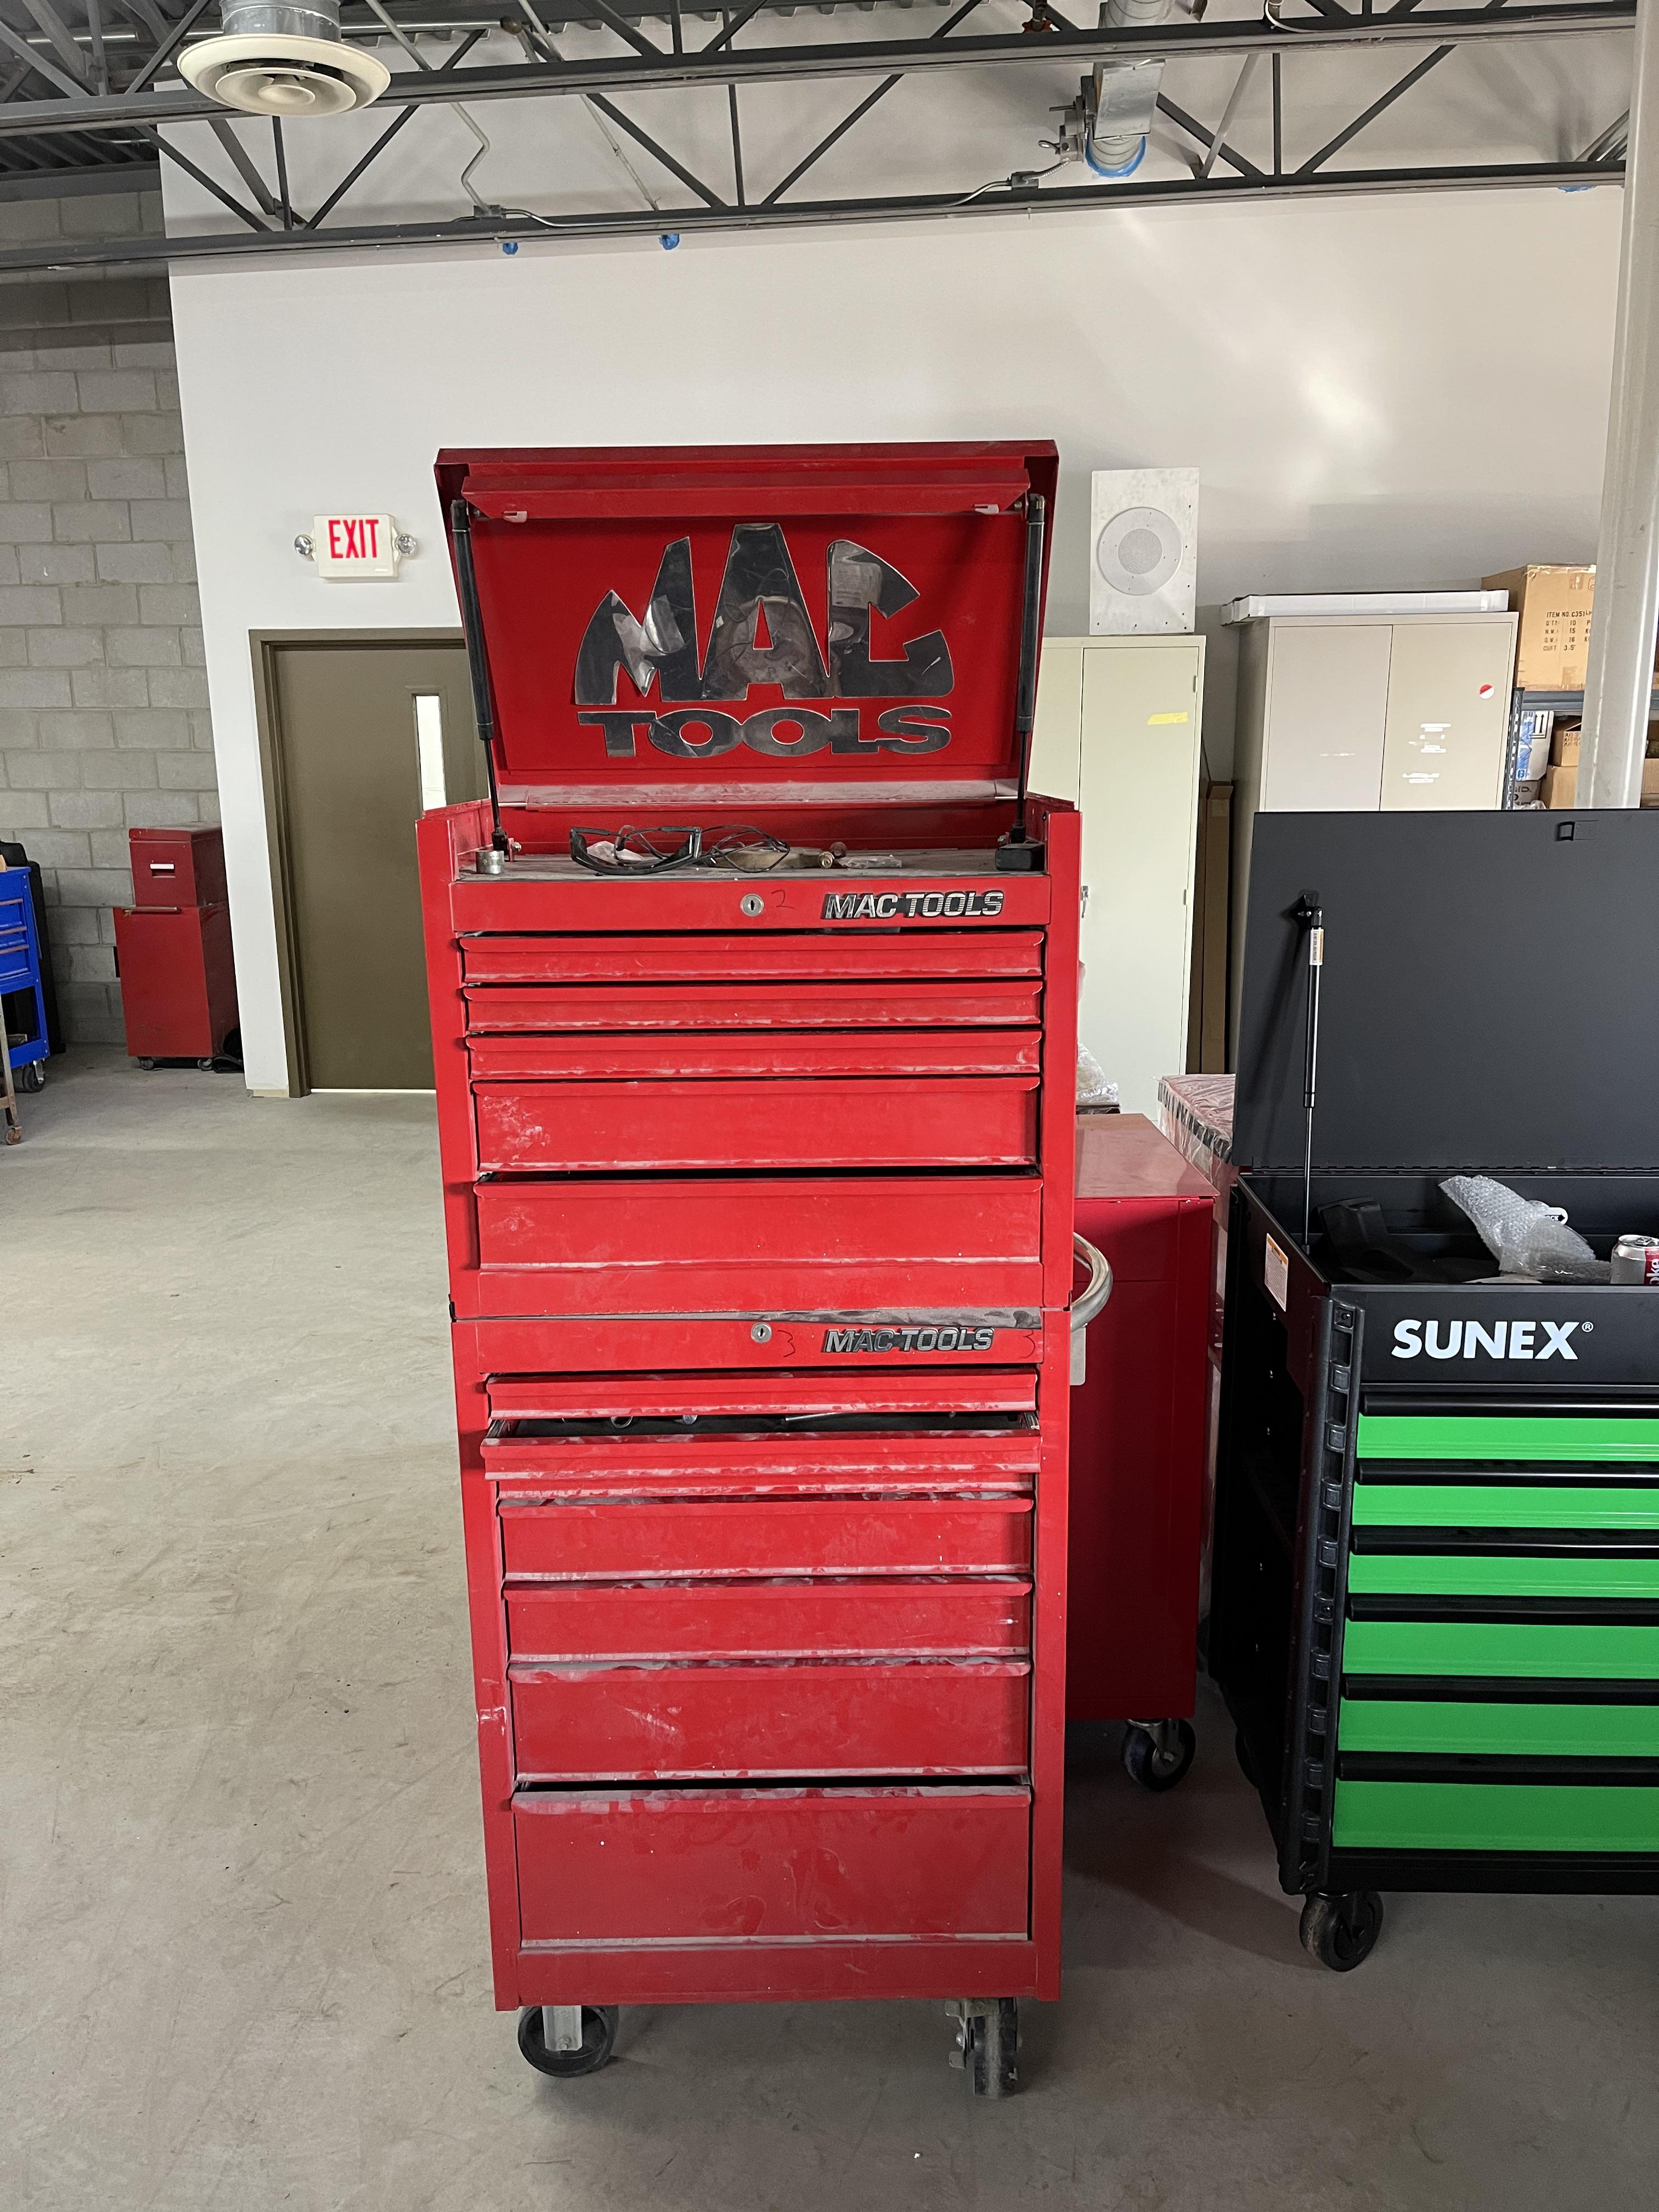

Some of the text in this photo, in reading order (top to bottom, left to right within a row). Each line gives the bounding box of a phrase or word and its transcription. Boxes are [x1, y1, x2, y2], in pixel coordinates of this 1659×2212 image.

[328, 519, 379, 558] EXIT
[575, 522, 955, 706] MAC
[578, 705, 952, 758] TOOLS
[825, 890, 1004, 919] MAC TOOLS
[825, 1327, 995, 1353] MAC TOOLS
